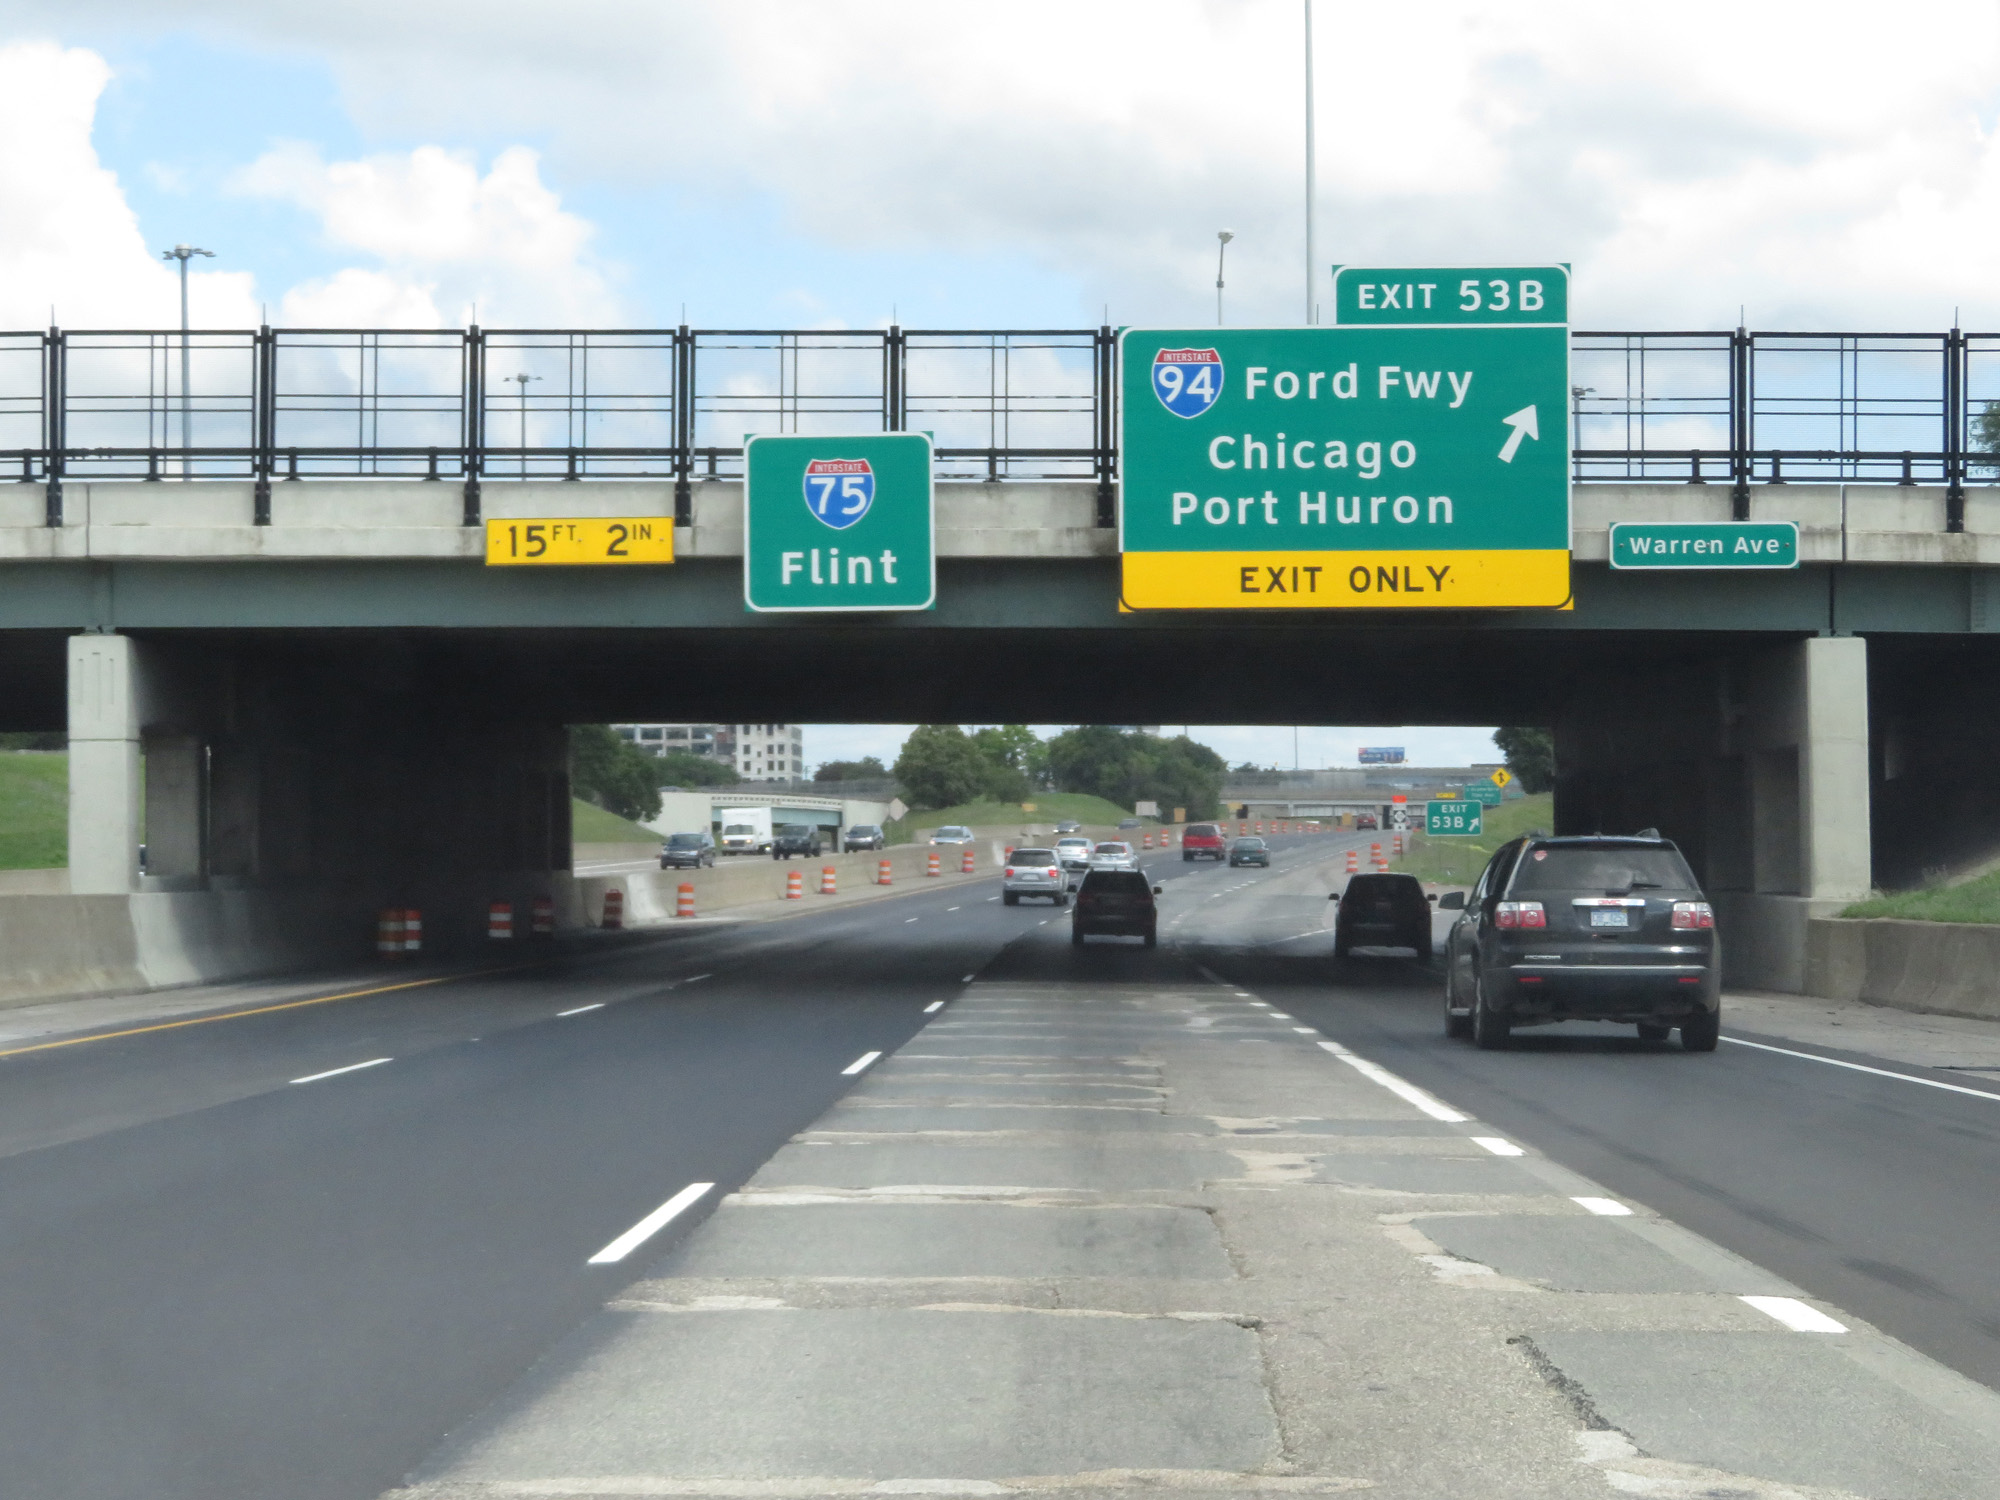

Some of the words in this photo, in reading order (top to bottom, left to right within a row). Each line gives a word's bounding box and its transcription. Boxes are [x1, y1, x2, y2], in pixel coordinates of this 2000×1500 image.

[1358, 283, 1437, 310] EXIT
[1458, 279, 1545, 312] 53B
[1163, 352, 1212, 362] INTERSTATE
[1158, 365, 1215, 403] 94
[1246, 363, 1358, 400] Ford
[1378, 365, 1473, 409] Fwy
[814, 463, 863, 473] INTERSTATE
[1208, 432, 1417, 479] Chicago
[810, 476, 867, 515] 75
[1172, 489, 1279, 526] Port
[1299, 490, 1454, 525] Huron
[1629, 537, 1724, 555] Warren
[1733, 536, 1780, 555] Ave
[781, 547, 898, 585] Flint
[1240, 565, 1323, 594] EXIT
[1349, 564, 1451, 593] ONLY
[1432, 816, 1464, 828] 53B
[1441, 804, 1468, 813] EXIT
